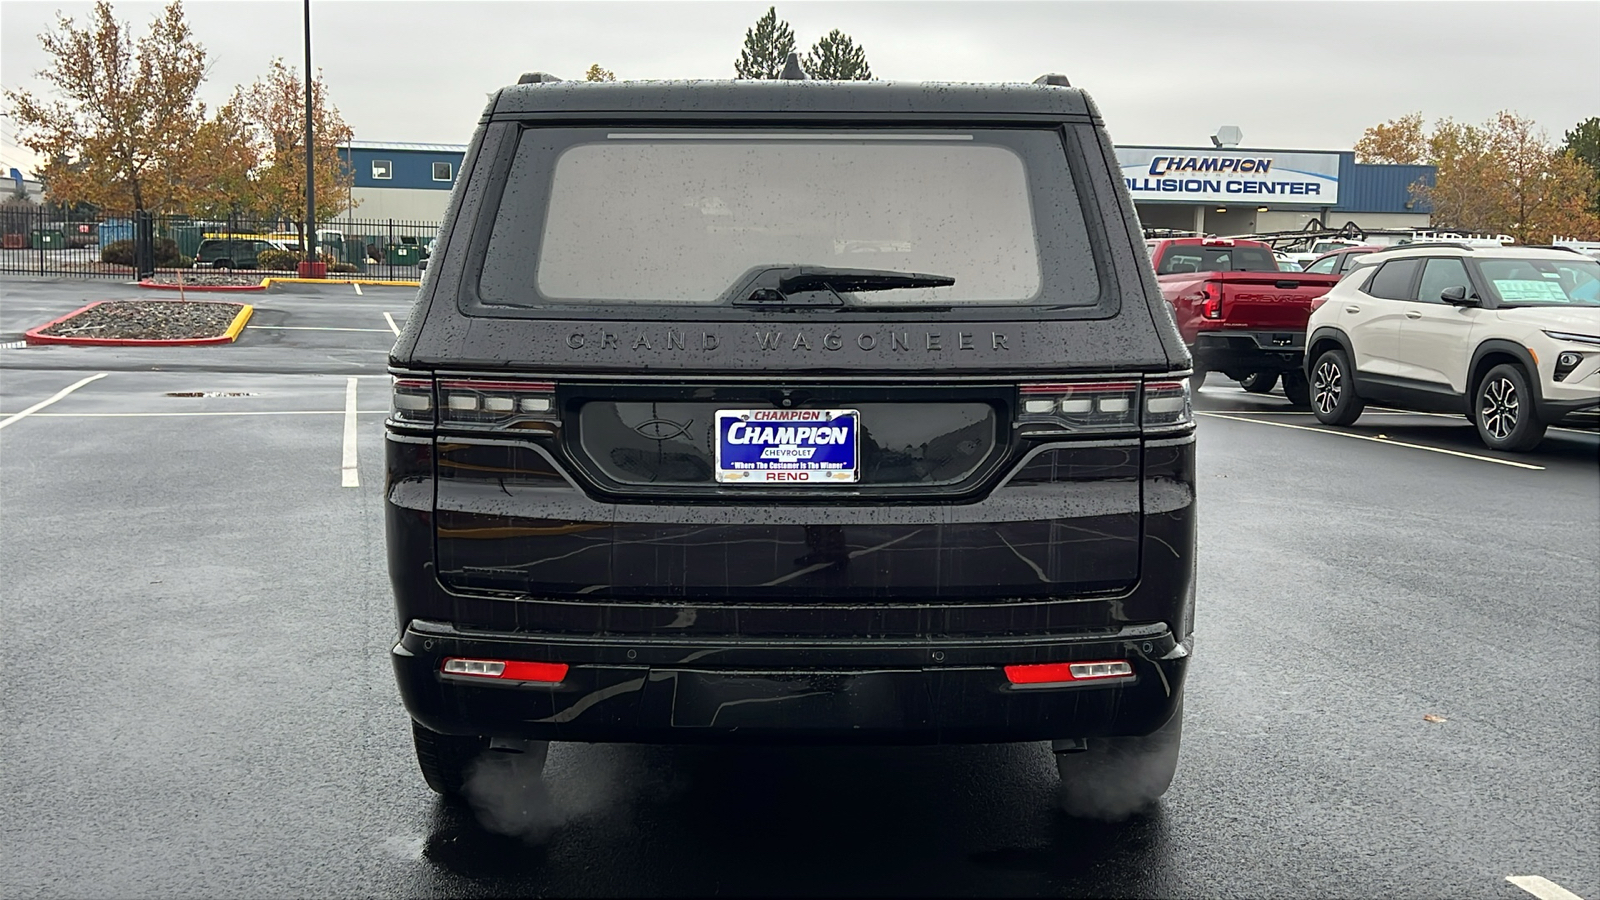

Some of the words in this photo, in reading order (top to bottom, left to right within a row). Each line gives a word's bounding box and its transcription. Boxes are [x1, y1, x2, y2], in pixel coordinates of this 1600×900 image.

[1149, 155, 1272, 176] CHAMPION
[1124, 178, 1221, 193] LLISION
[1225, 180, 1321, 195] CENTER
[565, 331, 721, 351] GRAND
[755, 331, 1010, 352] WAGONEER
[754, 411, 820, 420] CHAMPION
[727, 422, 848, 445] CHAMPION
[764, 449, 812, 457] CHEVROLET
[766, 472, 810, 481] RENO
